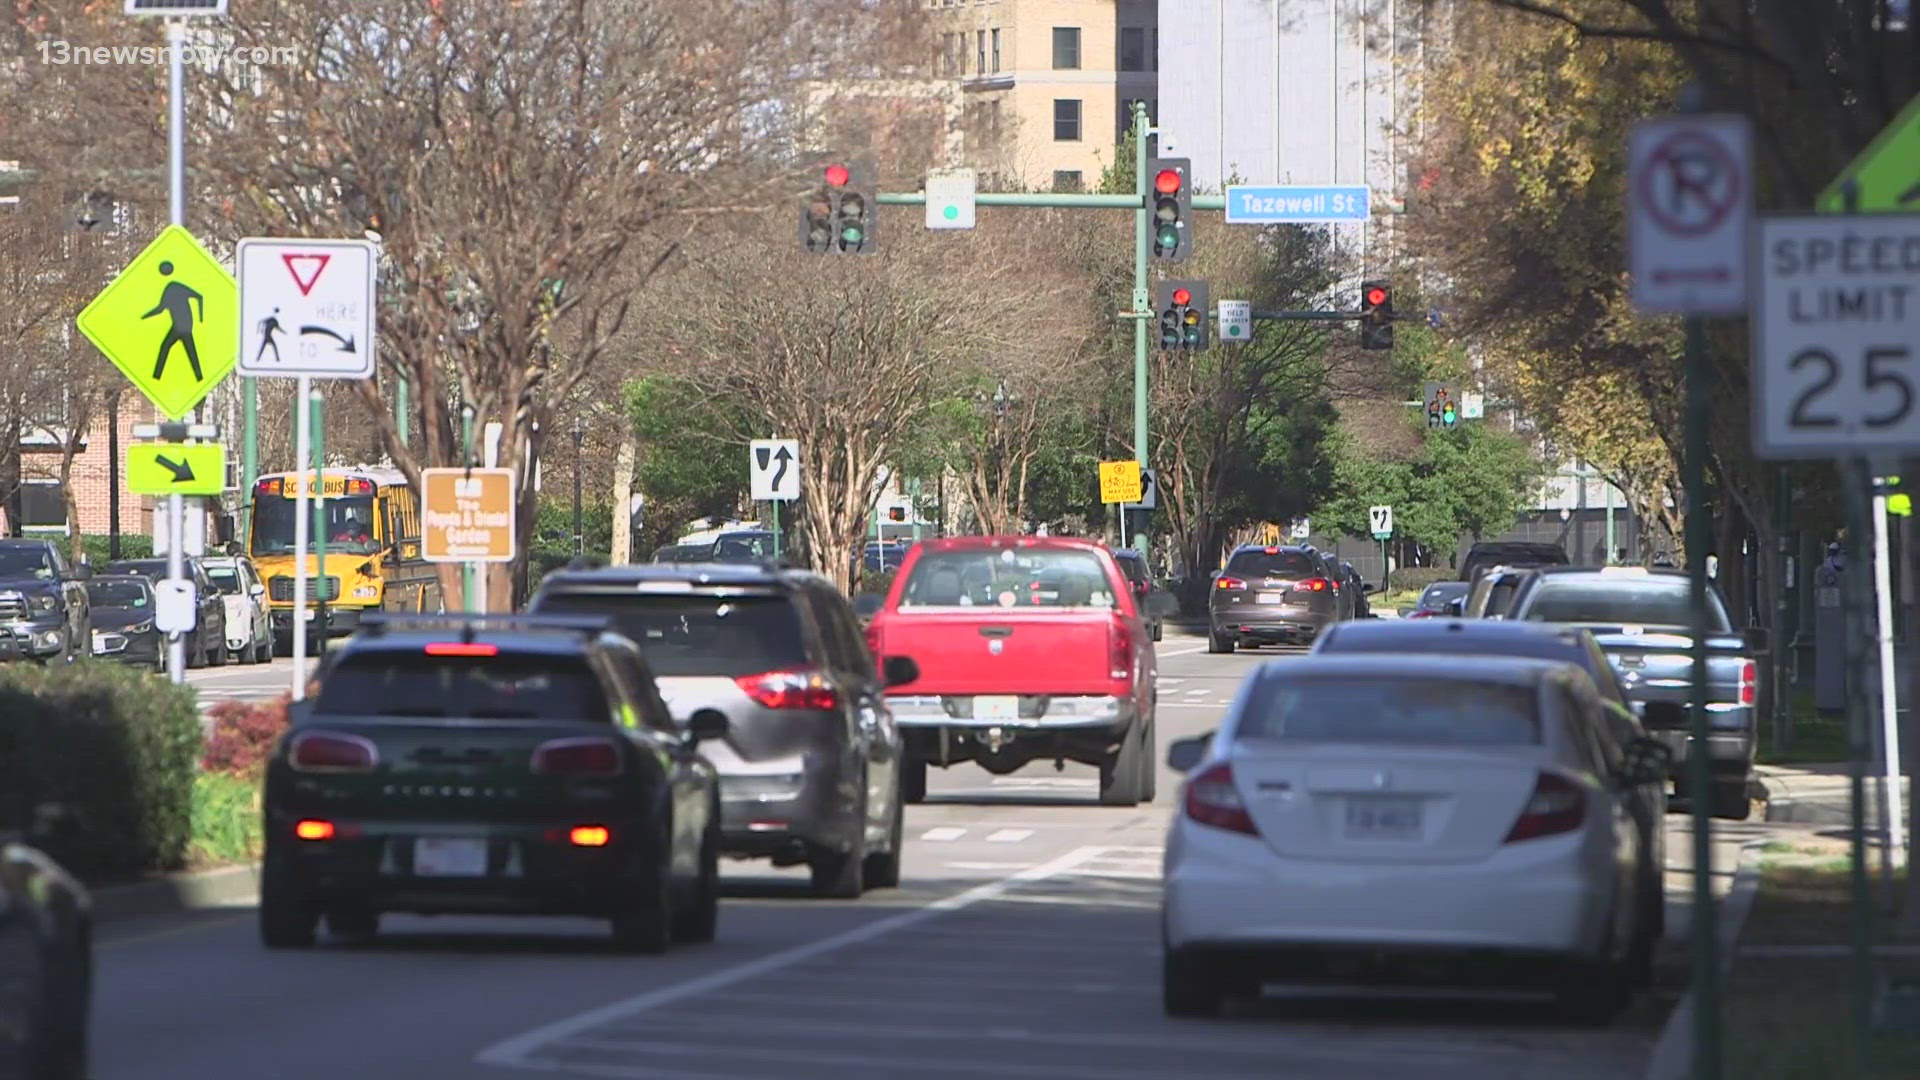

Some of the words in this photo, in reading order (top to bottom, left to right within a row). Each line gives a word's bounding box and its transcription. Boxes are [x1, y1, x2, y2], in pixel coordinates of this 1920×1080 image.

[1242, 193, 1325, 213] Tazewell
[1332, 193, 1355, 213] St
[1773, 234, 1920, 276] SPEED
[316, 303, 357, 321] HERE
[1787, 285, 1911, 323] LIMIT
[1787, 346, 1916, 429] 25
[325, 481, 343, 494] BUS
